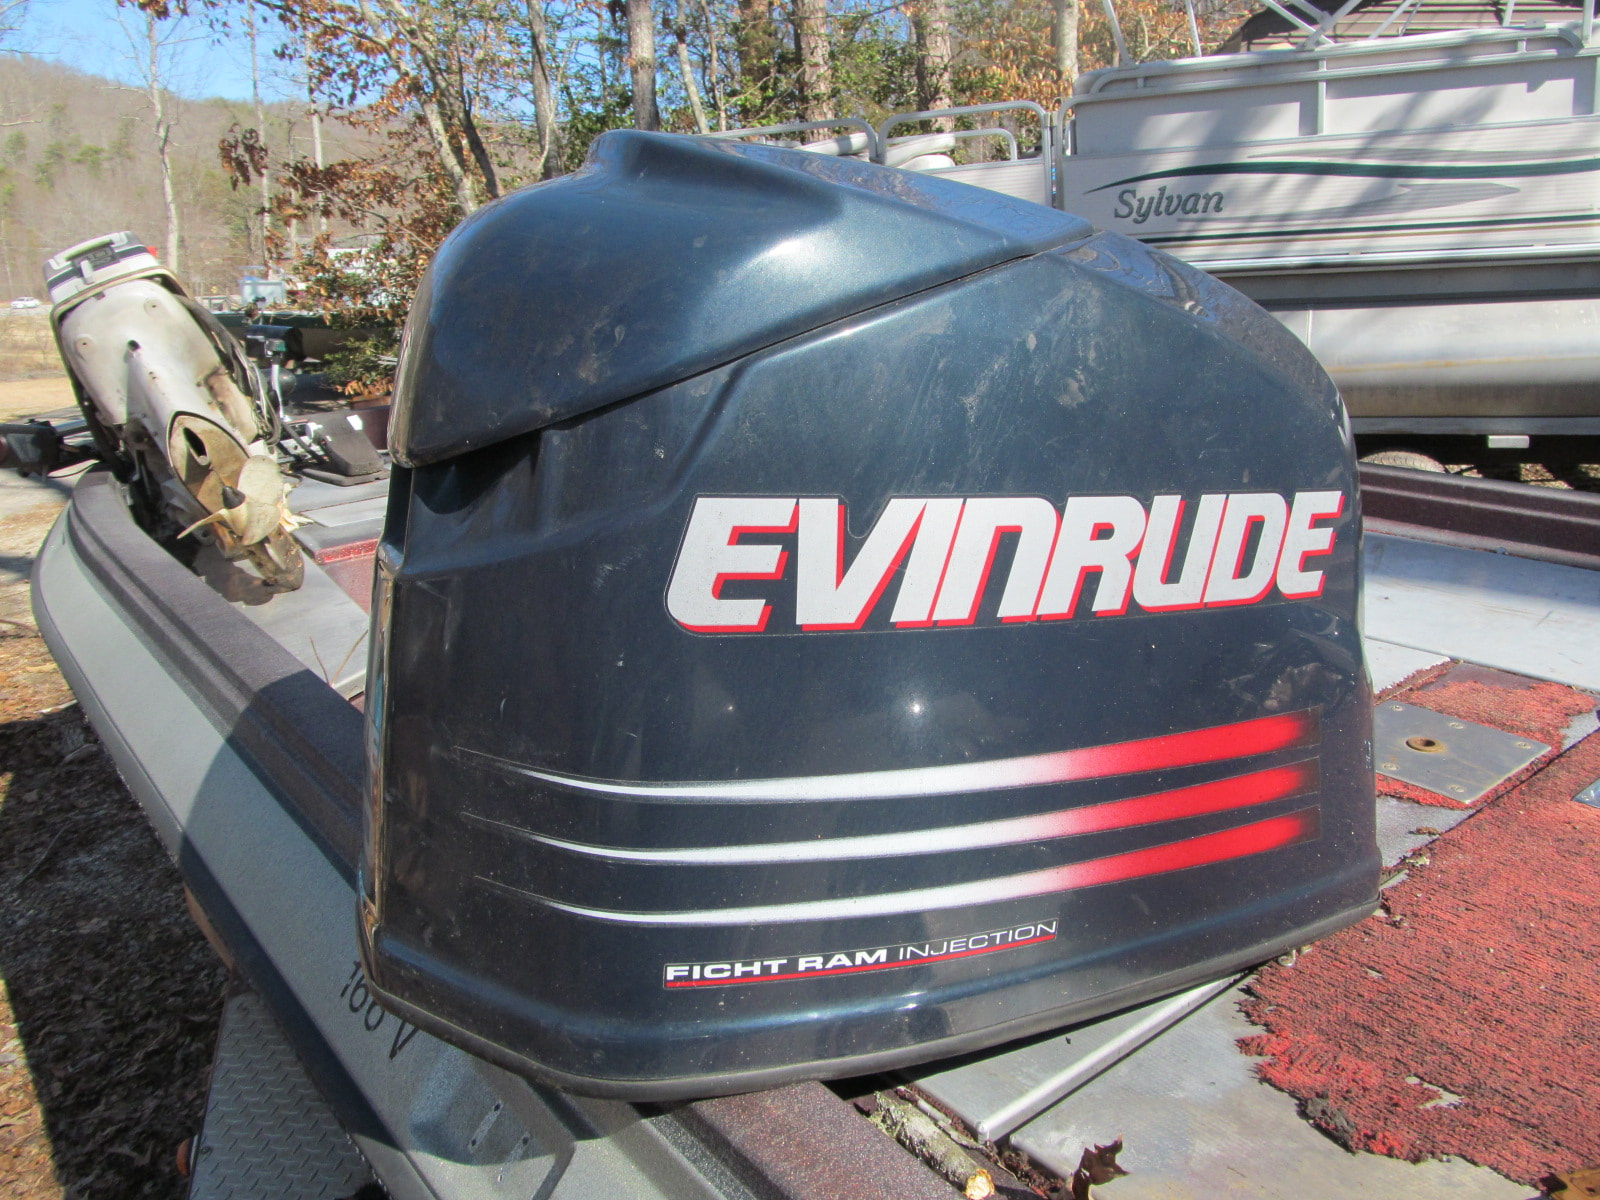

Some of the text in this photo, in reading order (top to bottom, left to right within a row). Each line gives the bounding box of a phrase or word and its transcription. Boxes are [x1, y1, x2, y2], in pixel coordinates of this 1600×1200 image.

[1114, 185, 1224, 224] Sylvan
[666, 490, 1345, 633] EVINRUDE
[666, 921, 1058, 981] FICHT RAM INJECTION
